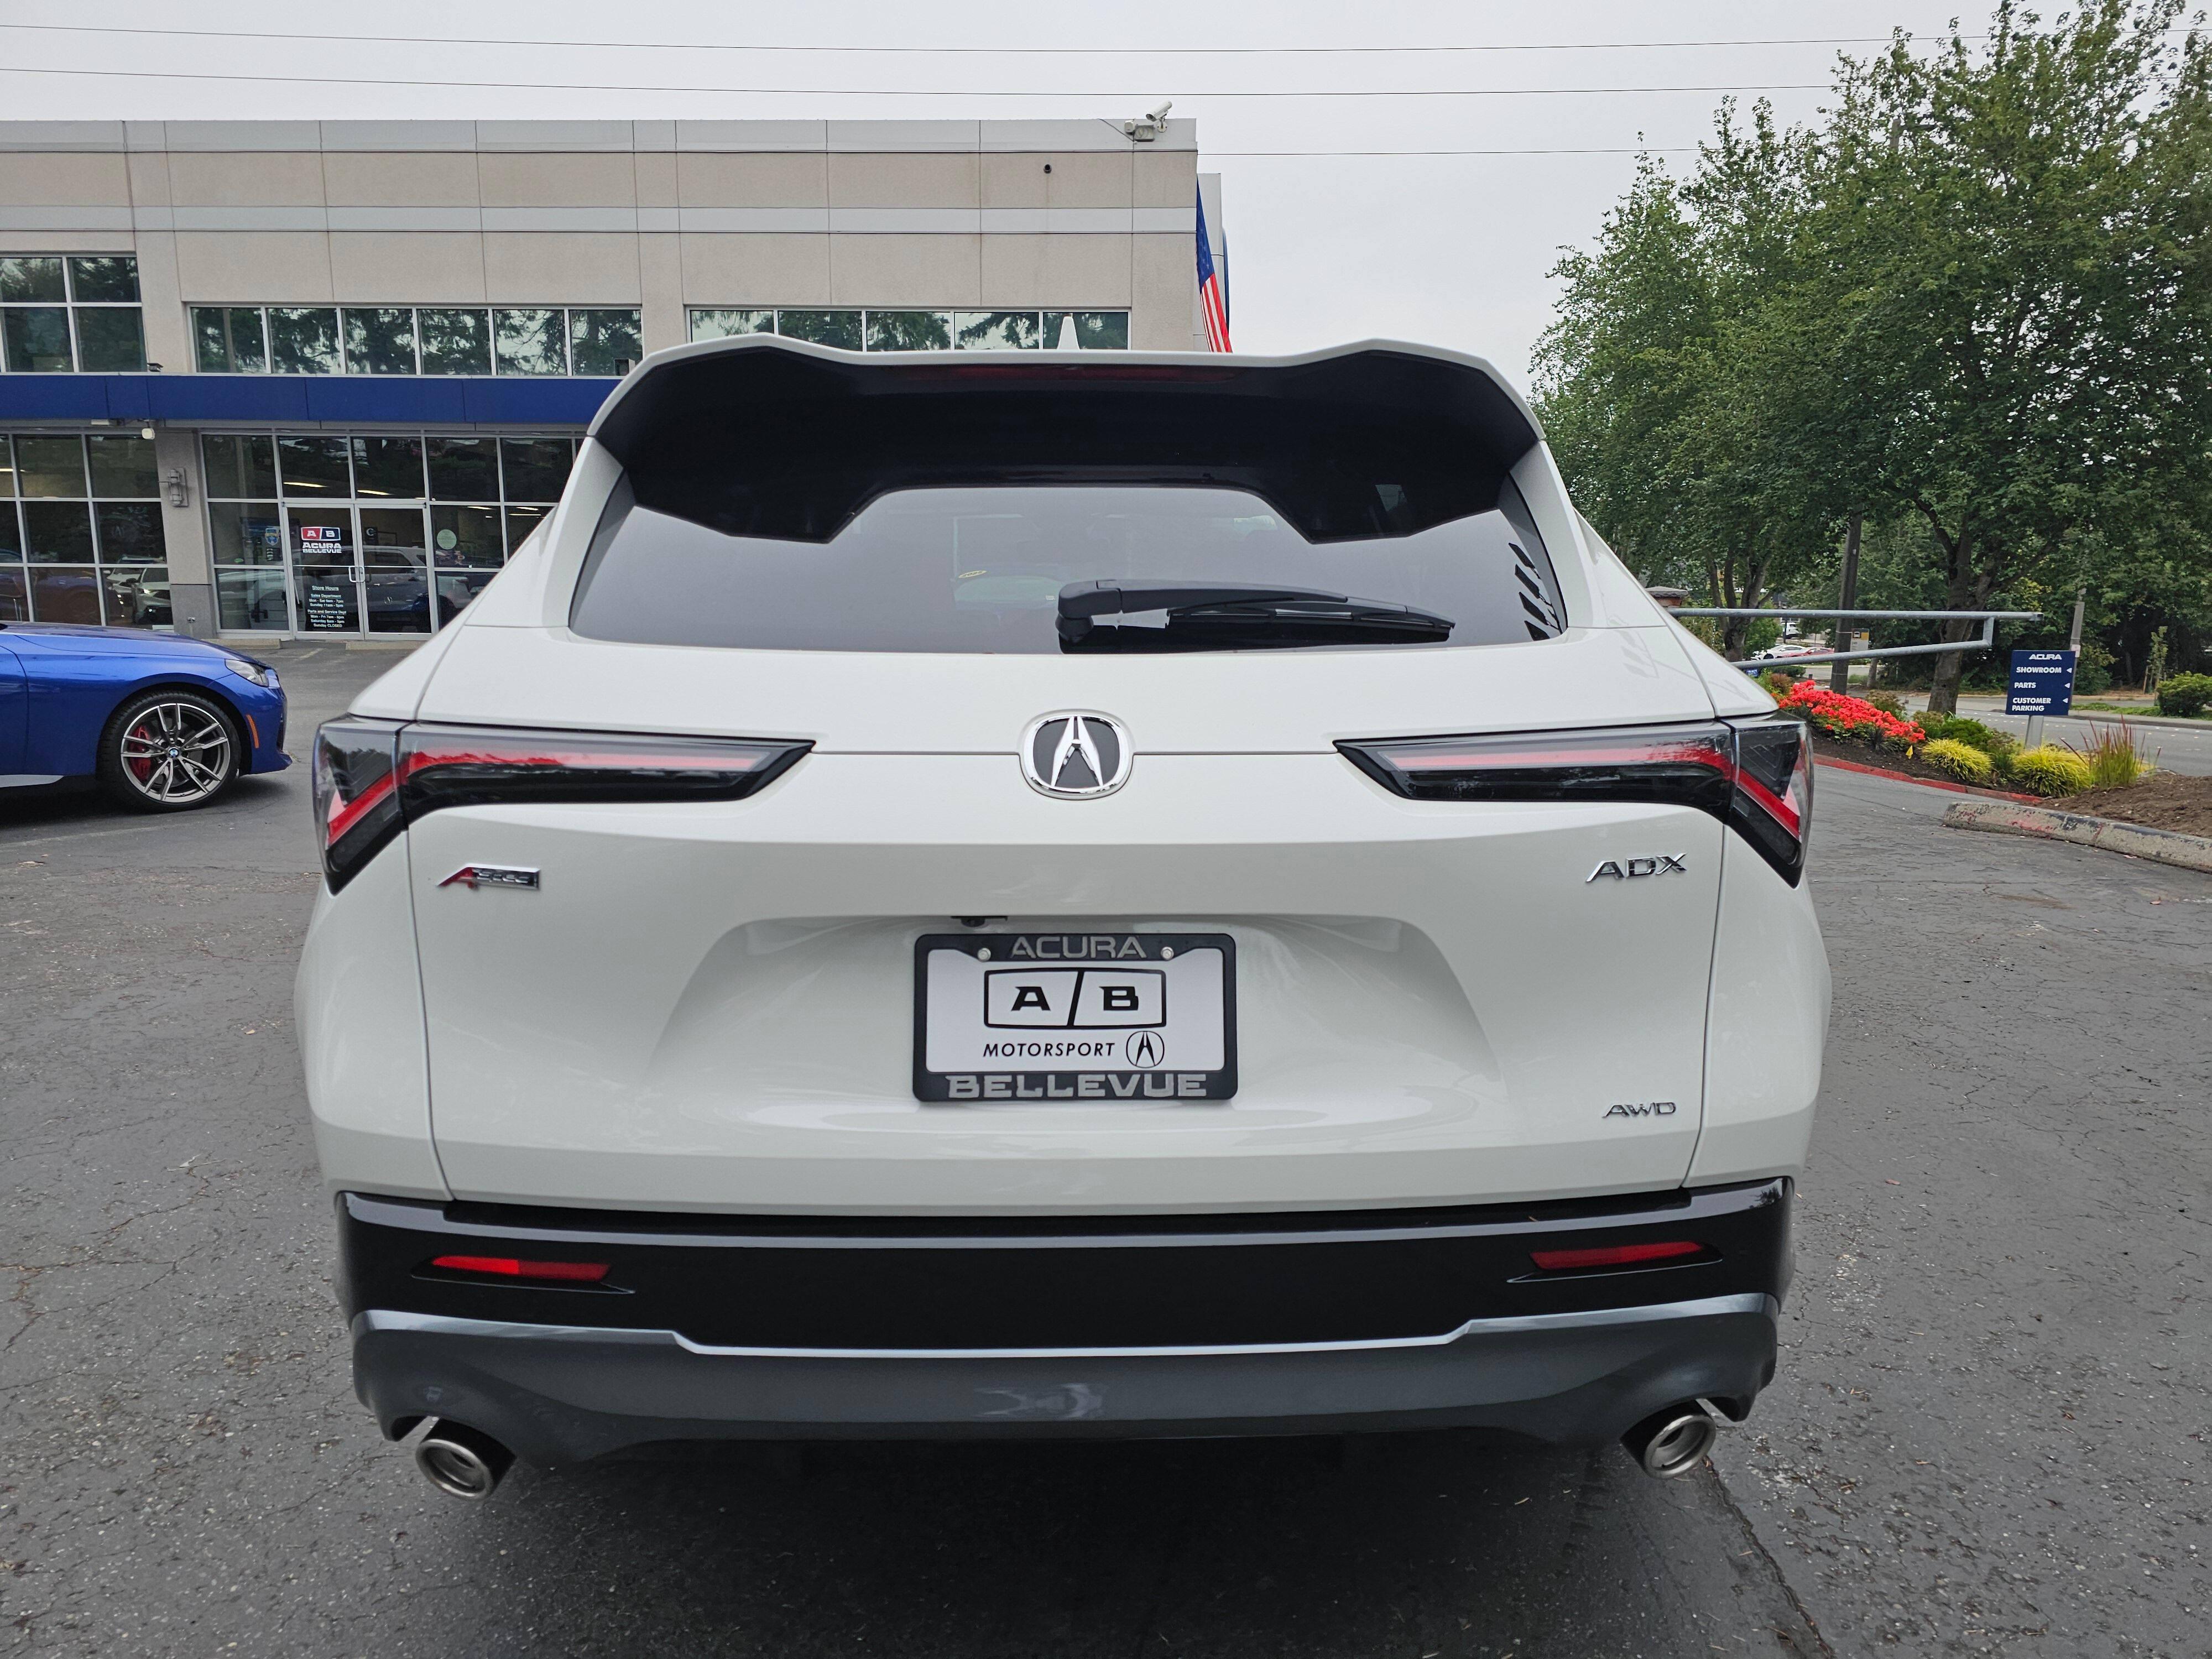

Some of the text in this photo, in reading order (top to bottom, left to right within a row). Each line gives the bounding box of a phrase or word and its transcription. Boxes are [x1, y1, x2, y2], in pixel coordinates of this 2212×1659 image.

[1585, 853, 1687, 883] ADX
[1010, 936, 1146, 959] ACURA
[983, 1042, 1116, 1057] MOTORSPORT
[945, 1073, 1207, 1099] BELLEVUE
[1601, 1102, 1677, 1119] AWD
